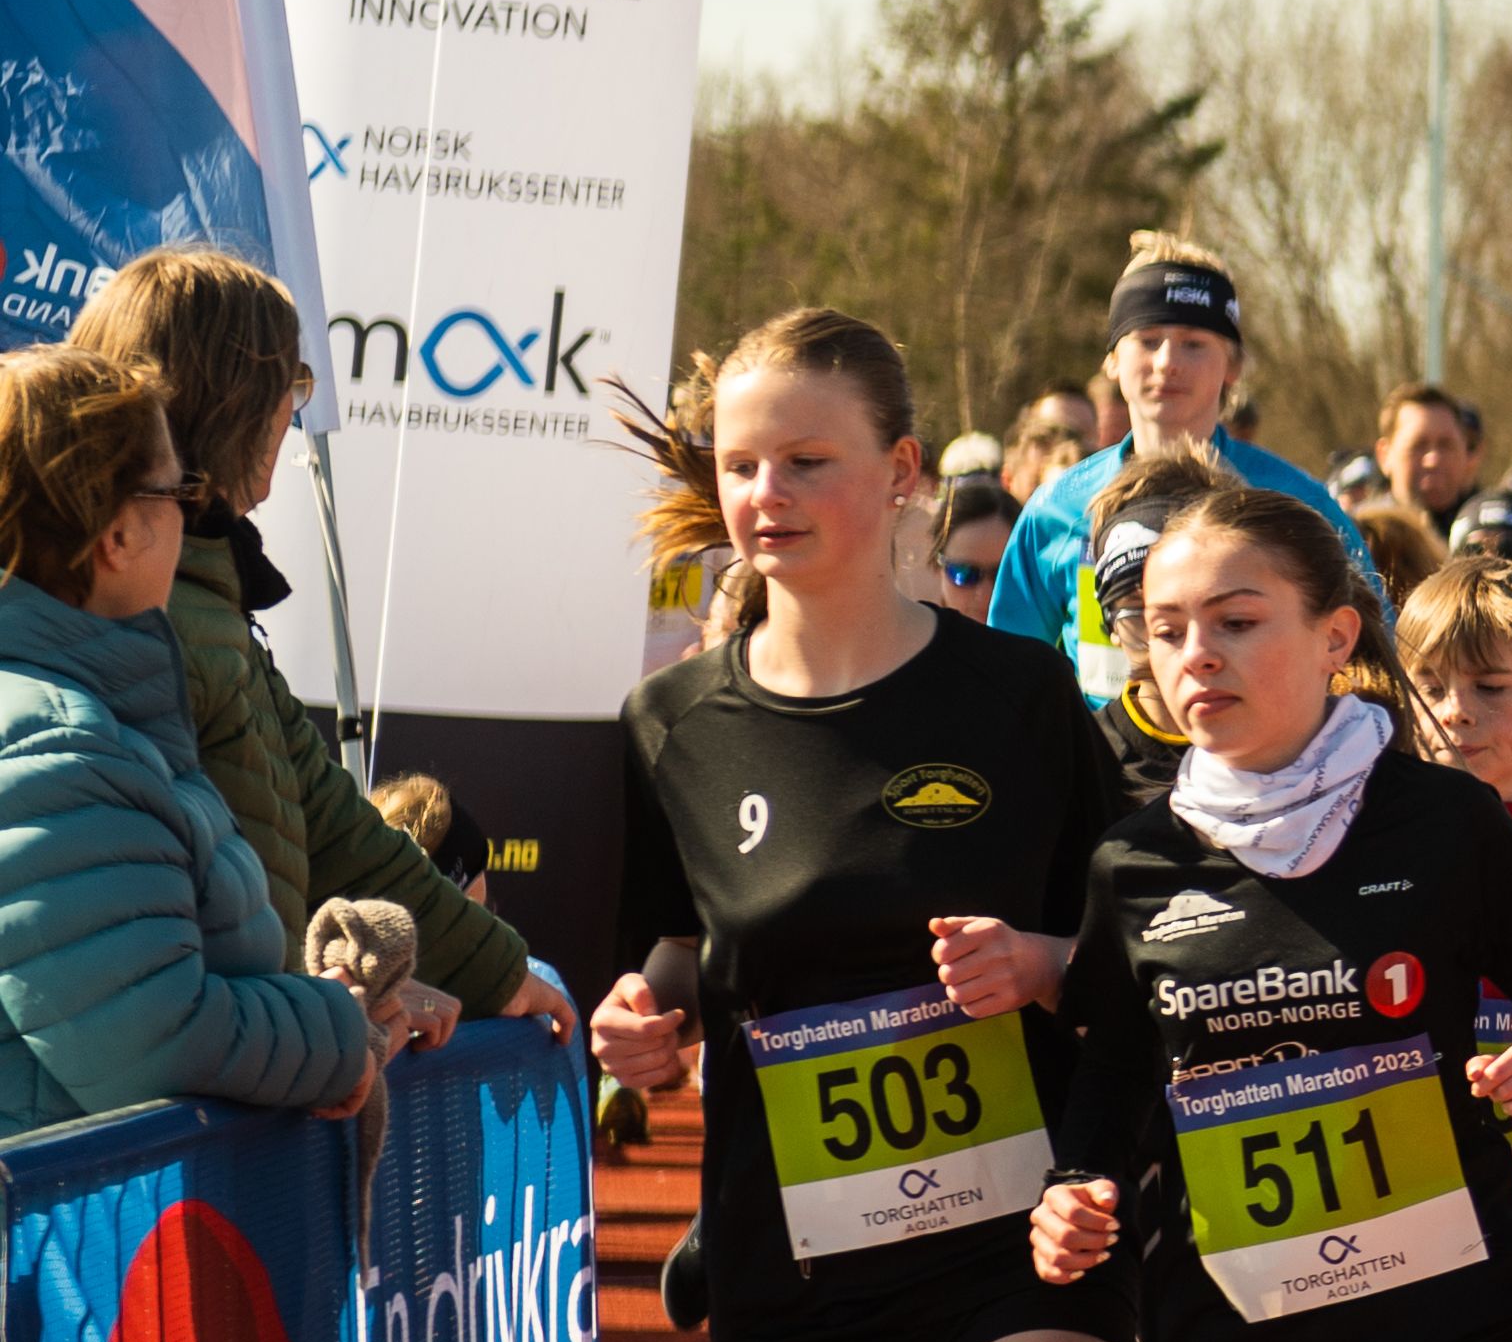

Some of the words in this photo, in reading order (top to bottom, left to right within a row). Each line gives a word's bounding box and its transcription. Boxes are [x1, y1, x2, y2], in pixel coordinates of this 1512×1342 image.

[362, 124, 473, 161] NORSK
[359, 162, 625, 209] HAVBRUKSSENTER
[347, 400, 589, 441] HAVBRUKSSENTER
[737, 792, 769, 855] 9
[1358, 881, 1401, 896] CRAFT
[1158, 959, 1359, 1020] SpareBank
[1384, 962, 1409, 1006] 1
[755, 1012, 867, 1054] Torghatten
[870, 994, 954, 1034] Maraton
[1206, 1001, 1363, 1034] NORD-NORGE
[816, 1042, 983, 1162] 503
[1177, 1078, 1284, 1119] Torghatten
[1288, 1061, 1370, 1099] Maraton
[1372, 1049, 1425, 1074] 2023
[1240, 1108, 1392, 1229] 511
[861, 1186, 984, 1231] TORGHATTEN
[905, 1215, 949, 1234] AQUA
[1282, 1251, 1407, 1297] TORGHATTEN
[1326, 1279, 1372, 1302] AQUA
